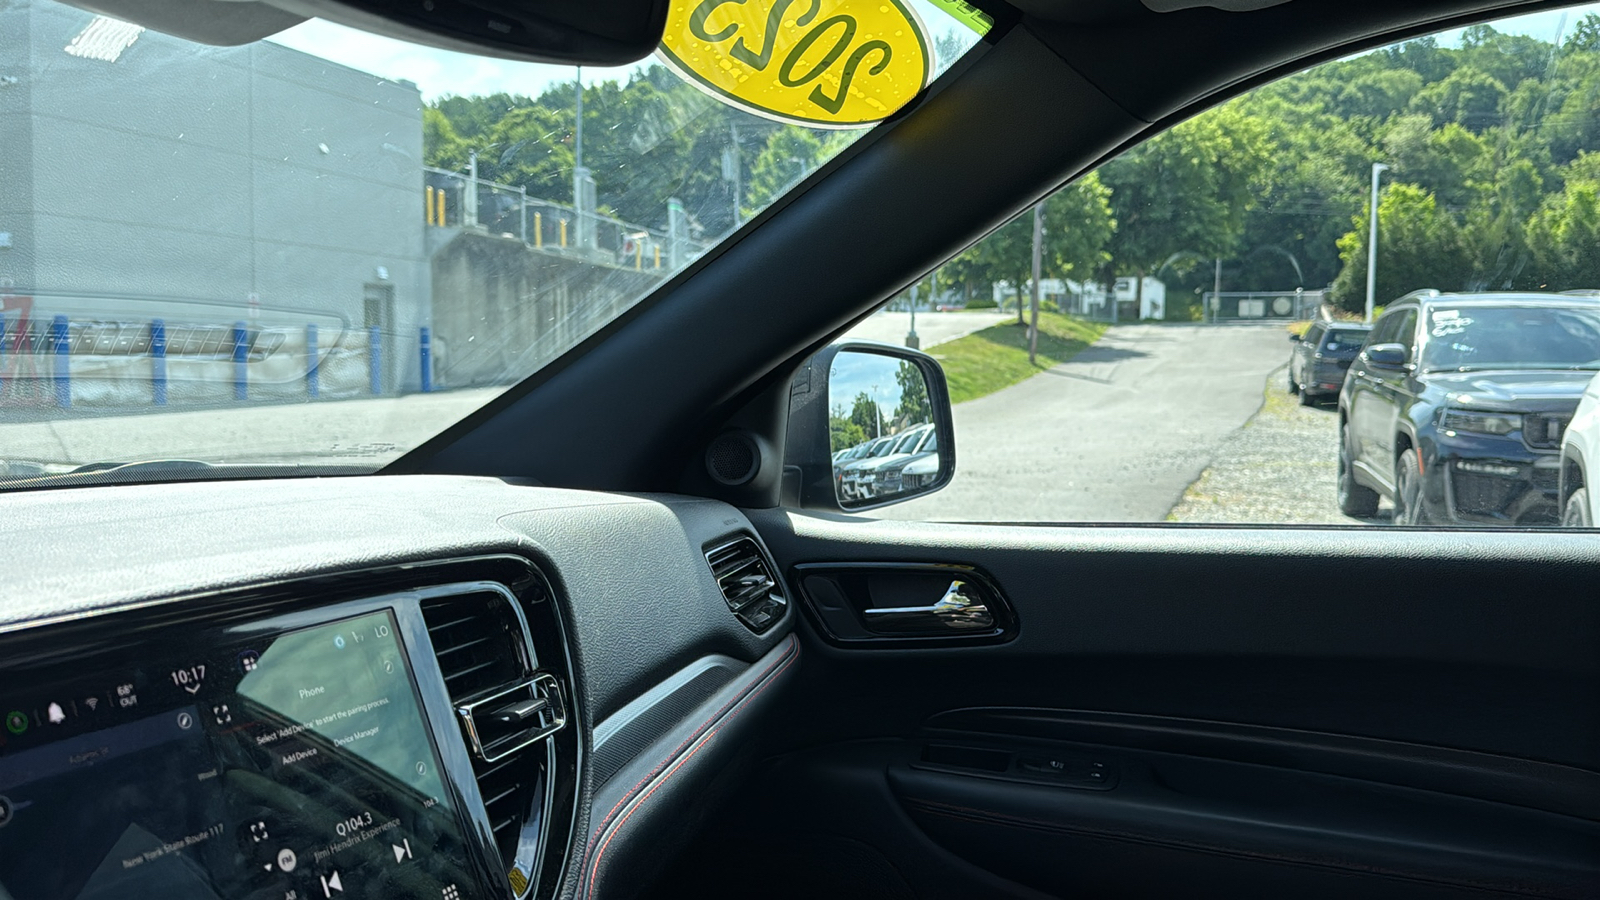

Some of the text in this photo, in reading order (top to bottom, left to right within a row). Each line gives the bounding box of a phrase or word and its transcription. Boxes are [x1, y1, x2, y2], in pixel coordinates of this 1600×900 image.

[374, 625, 389, 638] LO
[171, 664, 206, 686] 10:17
[299, 685, 325, 699] Phone
[256, 733, 279, 745] Select
[315, 717, 324, 726] to
[323, 713, 338, 724] start
[336, 711, 348, 719] the
[347, 703, 368, 717] pairing
[333, 726, 380, 747] Device Manager
[282, 747, 318, 765] Add Device
[335, 811, 374, 838] Q104.3
[184, 831, 210, 845] Route
[313, 817, 402, 864] Jimi Hendrix Experience
[281, 854, 294, 867] FM
